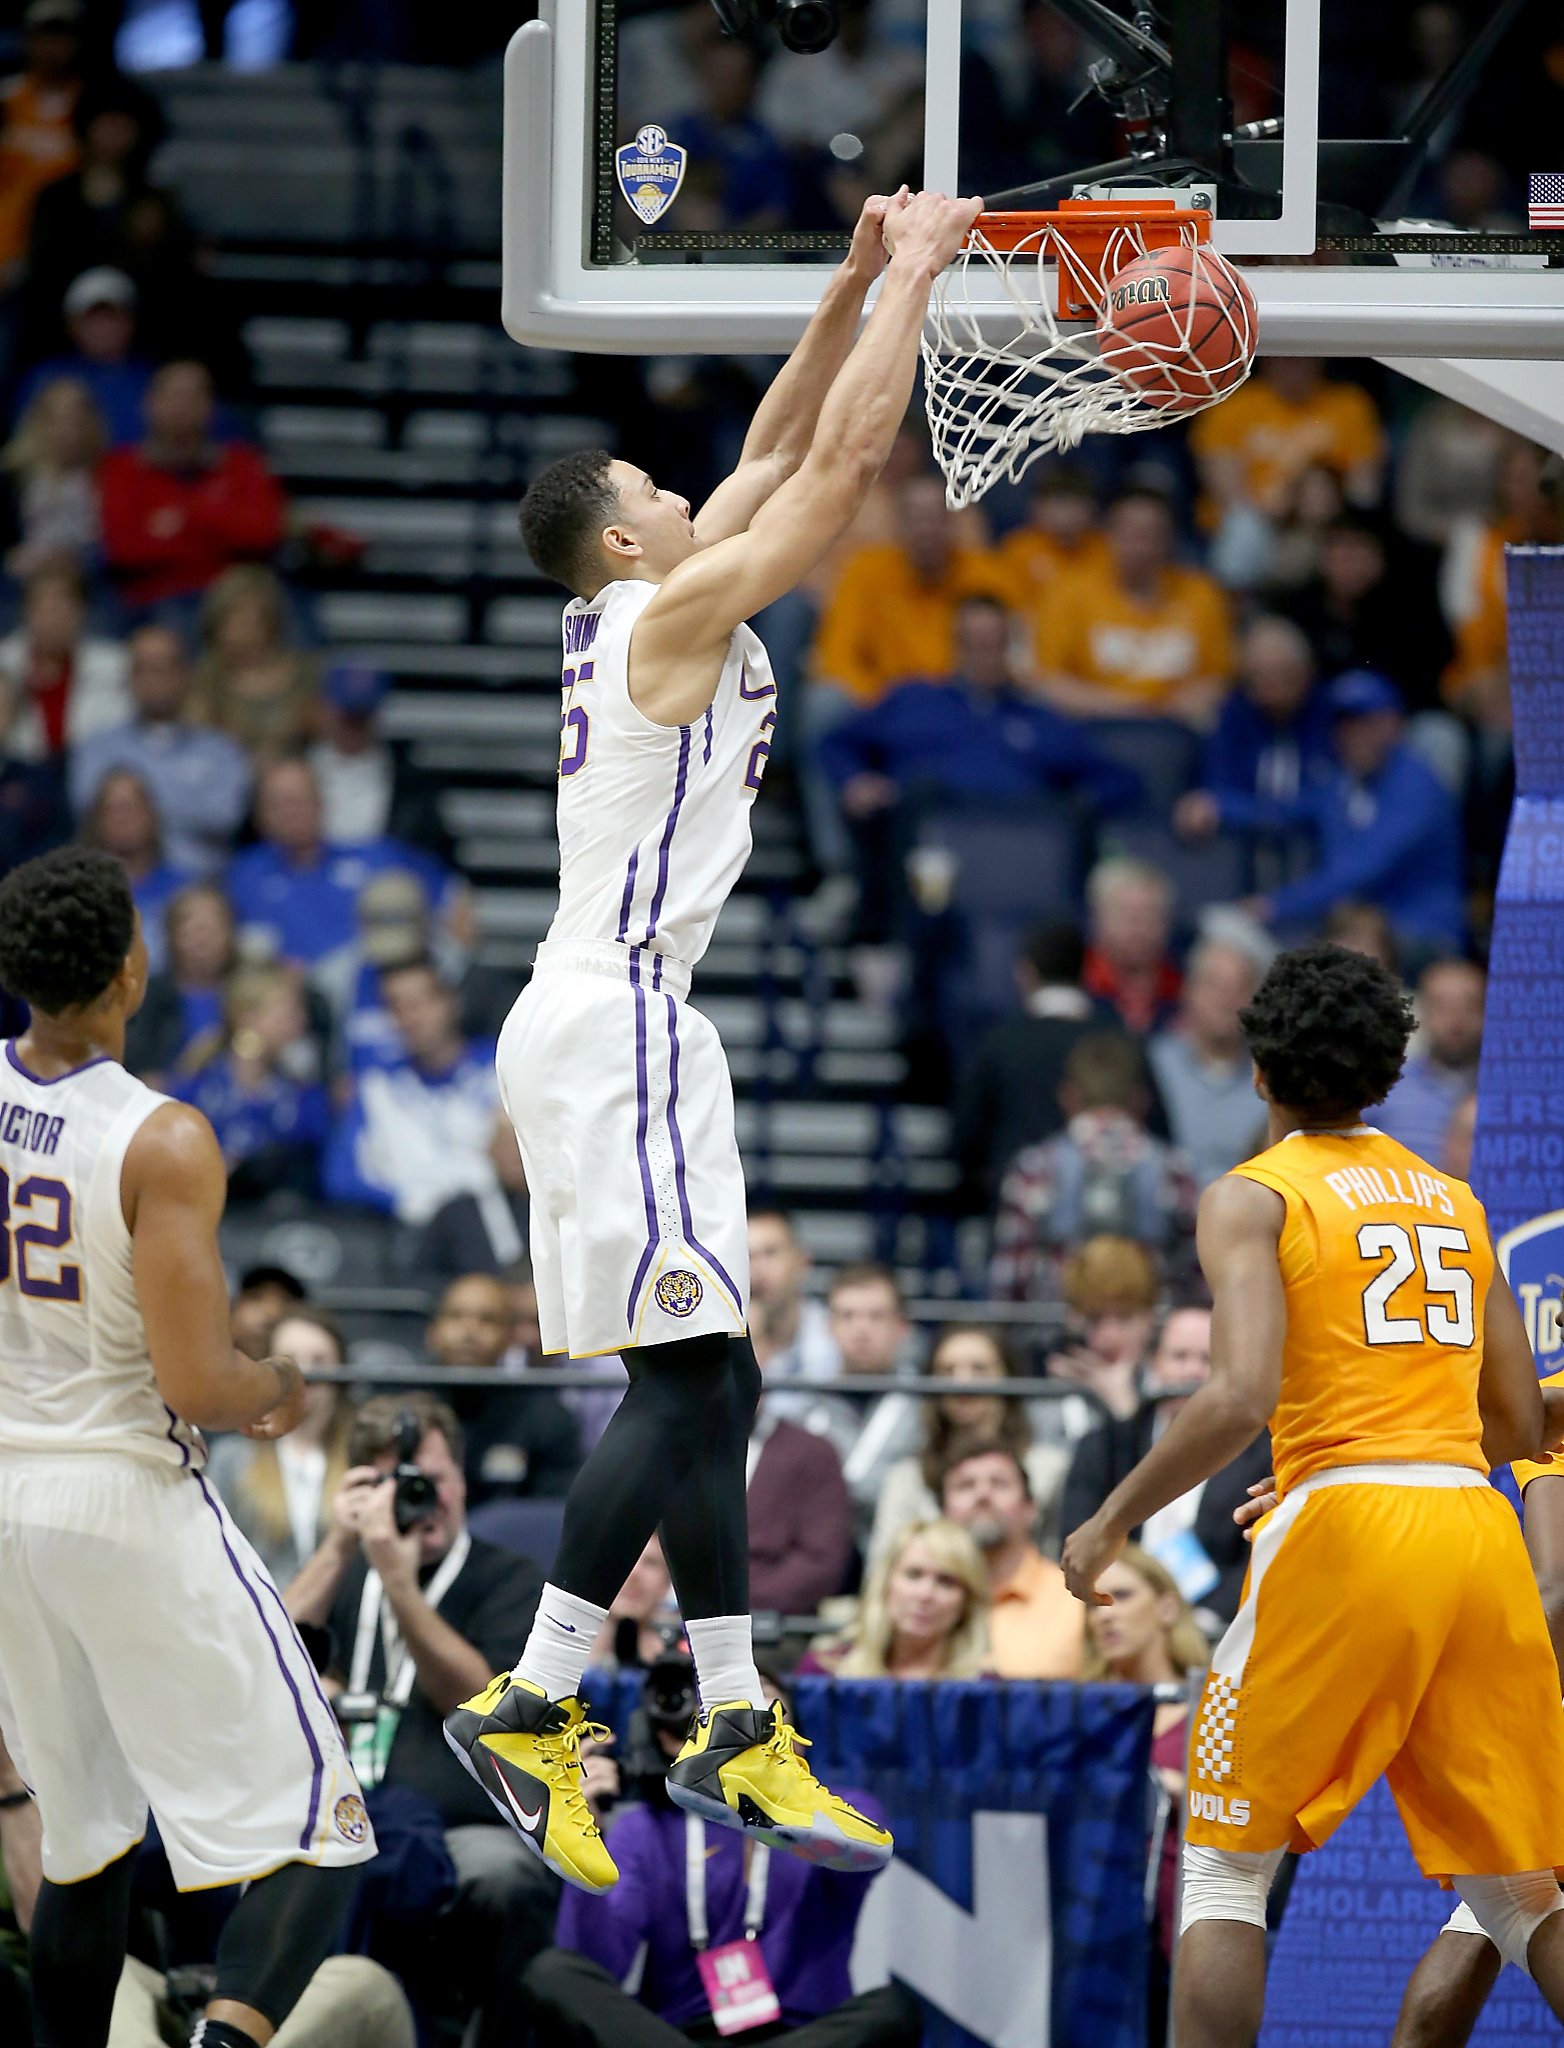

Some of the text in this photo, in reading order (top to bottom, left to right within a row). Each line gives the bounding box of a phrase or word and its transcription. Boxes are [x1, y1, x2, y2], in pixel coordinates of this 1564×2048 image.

[637, 128, 665, 154] SEC
[620, 161, 680, 178] TOURNAMENT
[1324, 1165, 1455, 1217] PHILLIPS
[0, 1160, 82, 1303] 2
[1356, 1223, 1476, 1349] 25
[1189, 1789, 1251, 1826] VOLS
